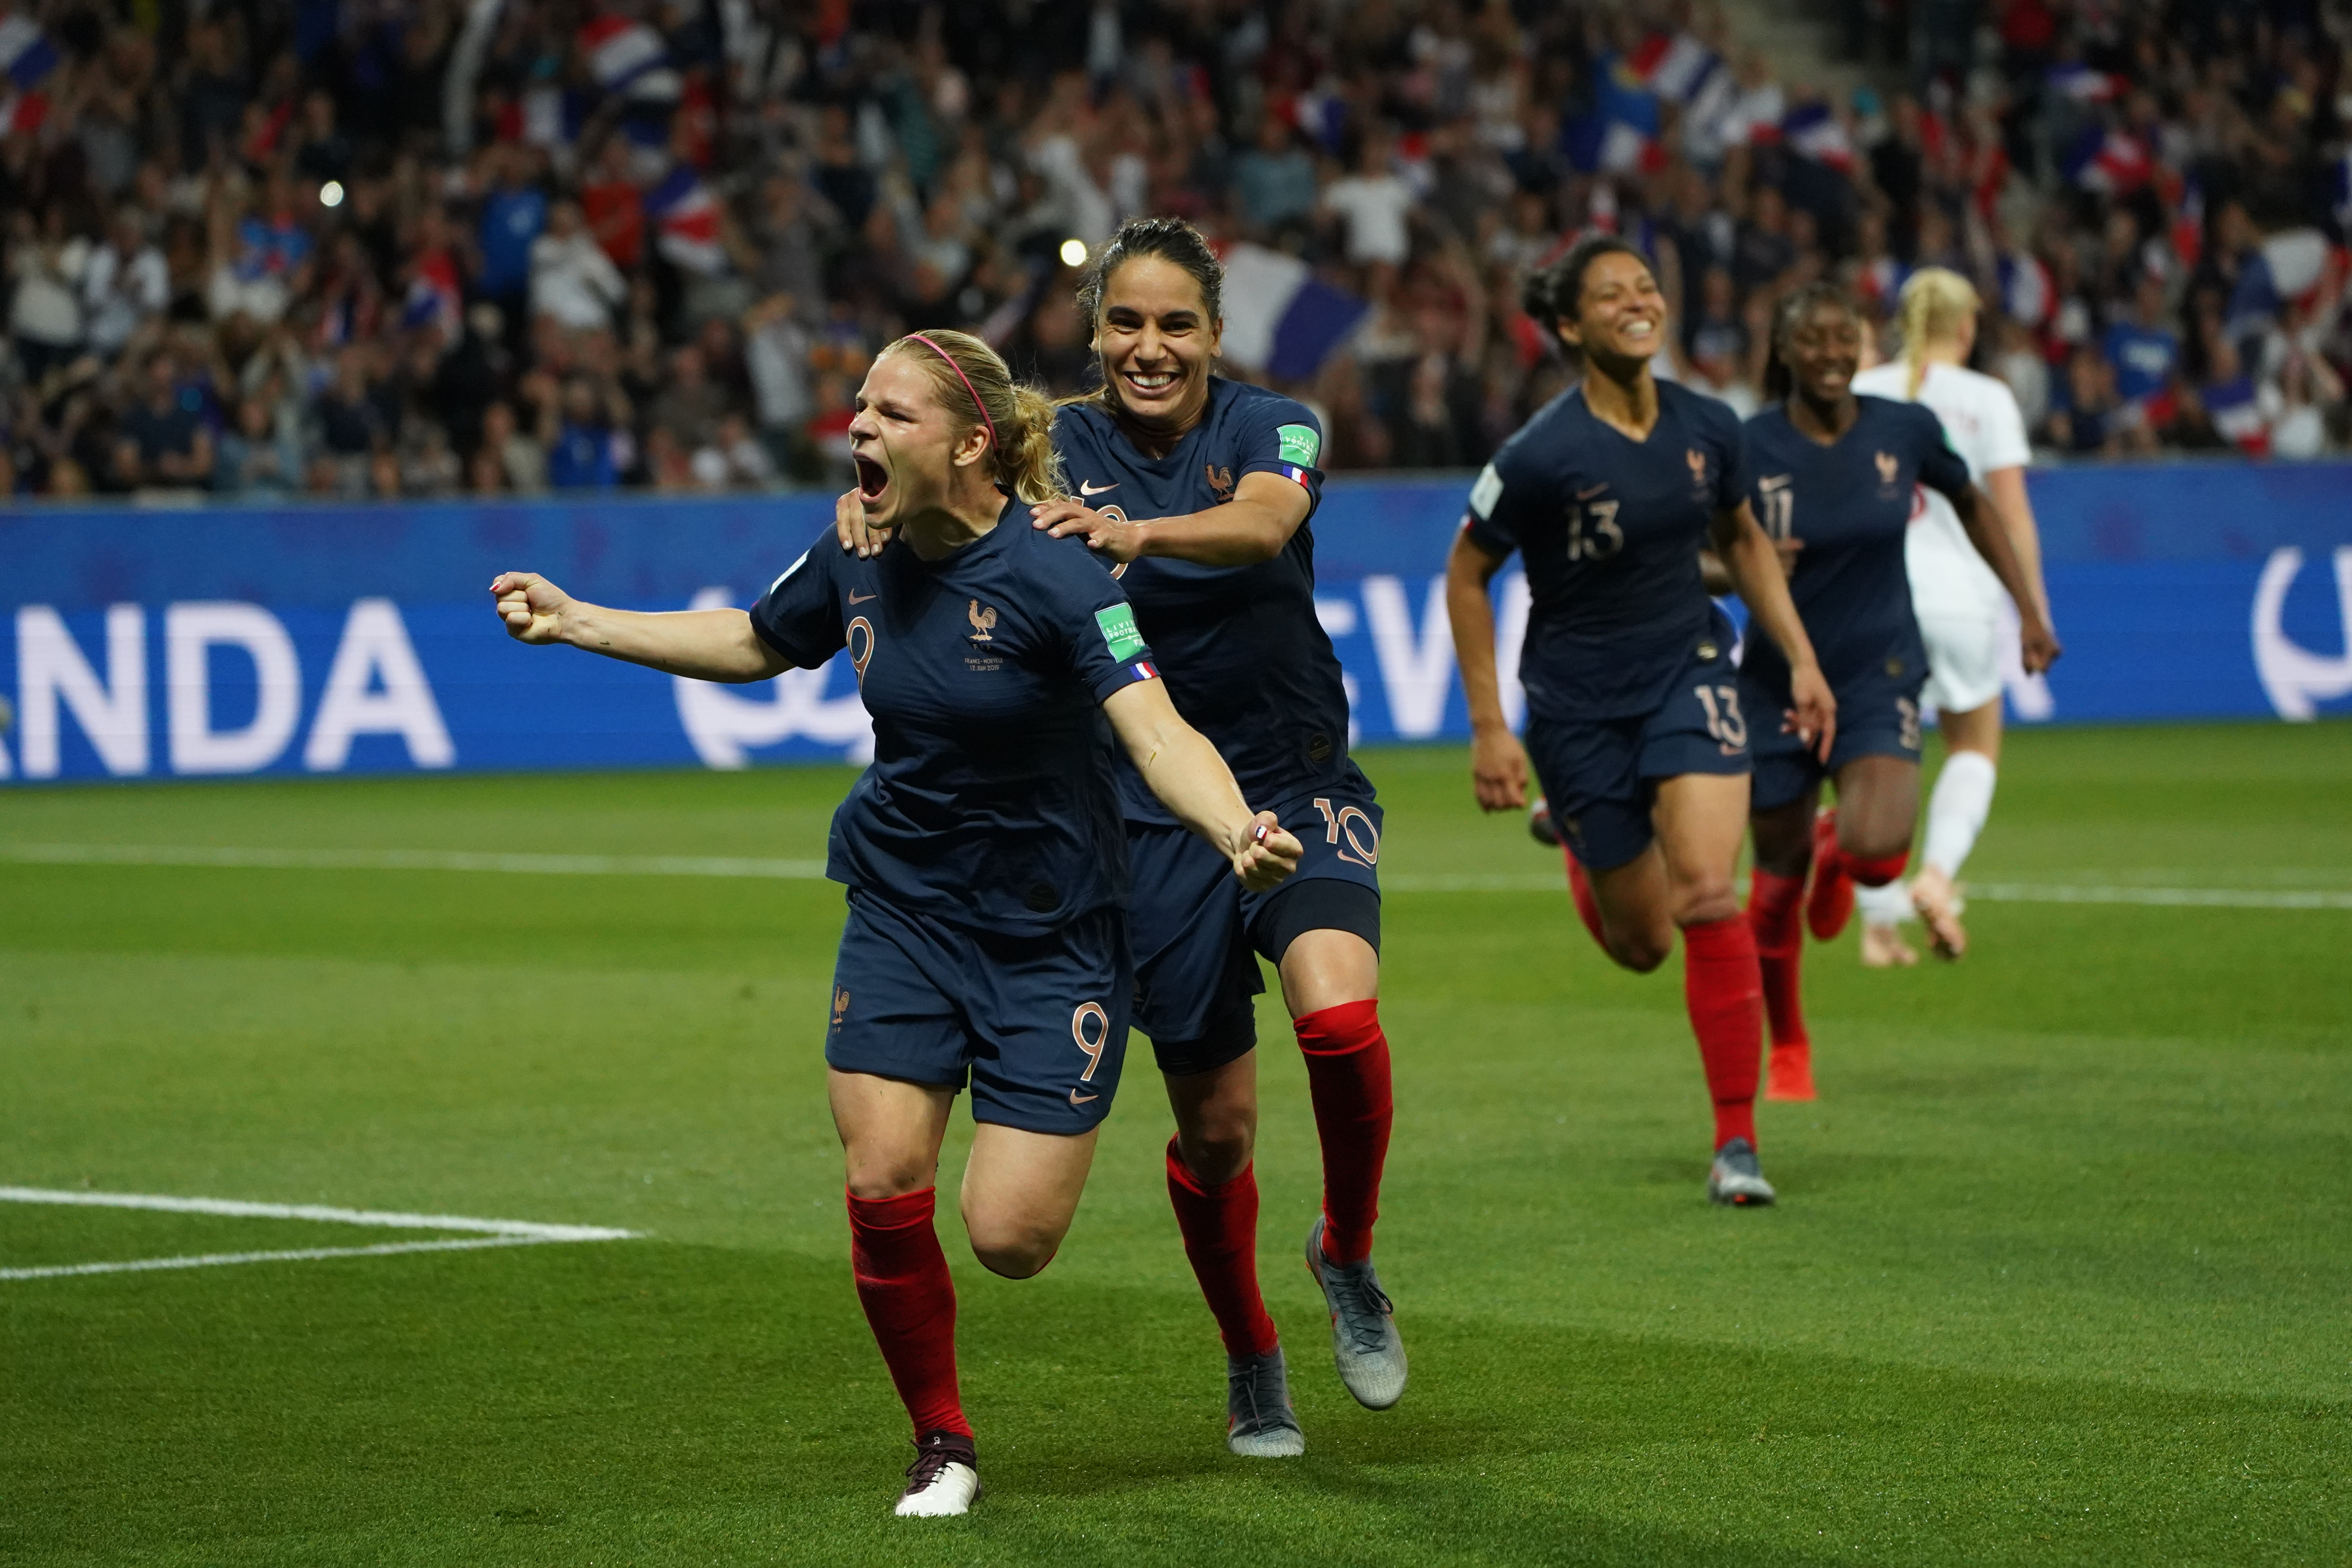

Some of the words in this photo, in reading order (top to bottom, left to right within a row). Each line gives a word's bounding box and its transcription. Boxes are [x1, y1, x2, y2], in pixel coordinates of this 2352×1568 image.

[1567, 499, 1624, 561] 13
[846, 616, 875, 697] 9
[1106, 620, 1135, 633] LIVI
[1109, 626, 1138, 639] FOOTBA
[0, 598, 458, 779] NDA
[1694, 685, 1747, 747] 13
[1314, 798, 1379, 864] 10
[1072, 1002, 1109, 1082] 9
